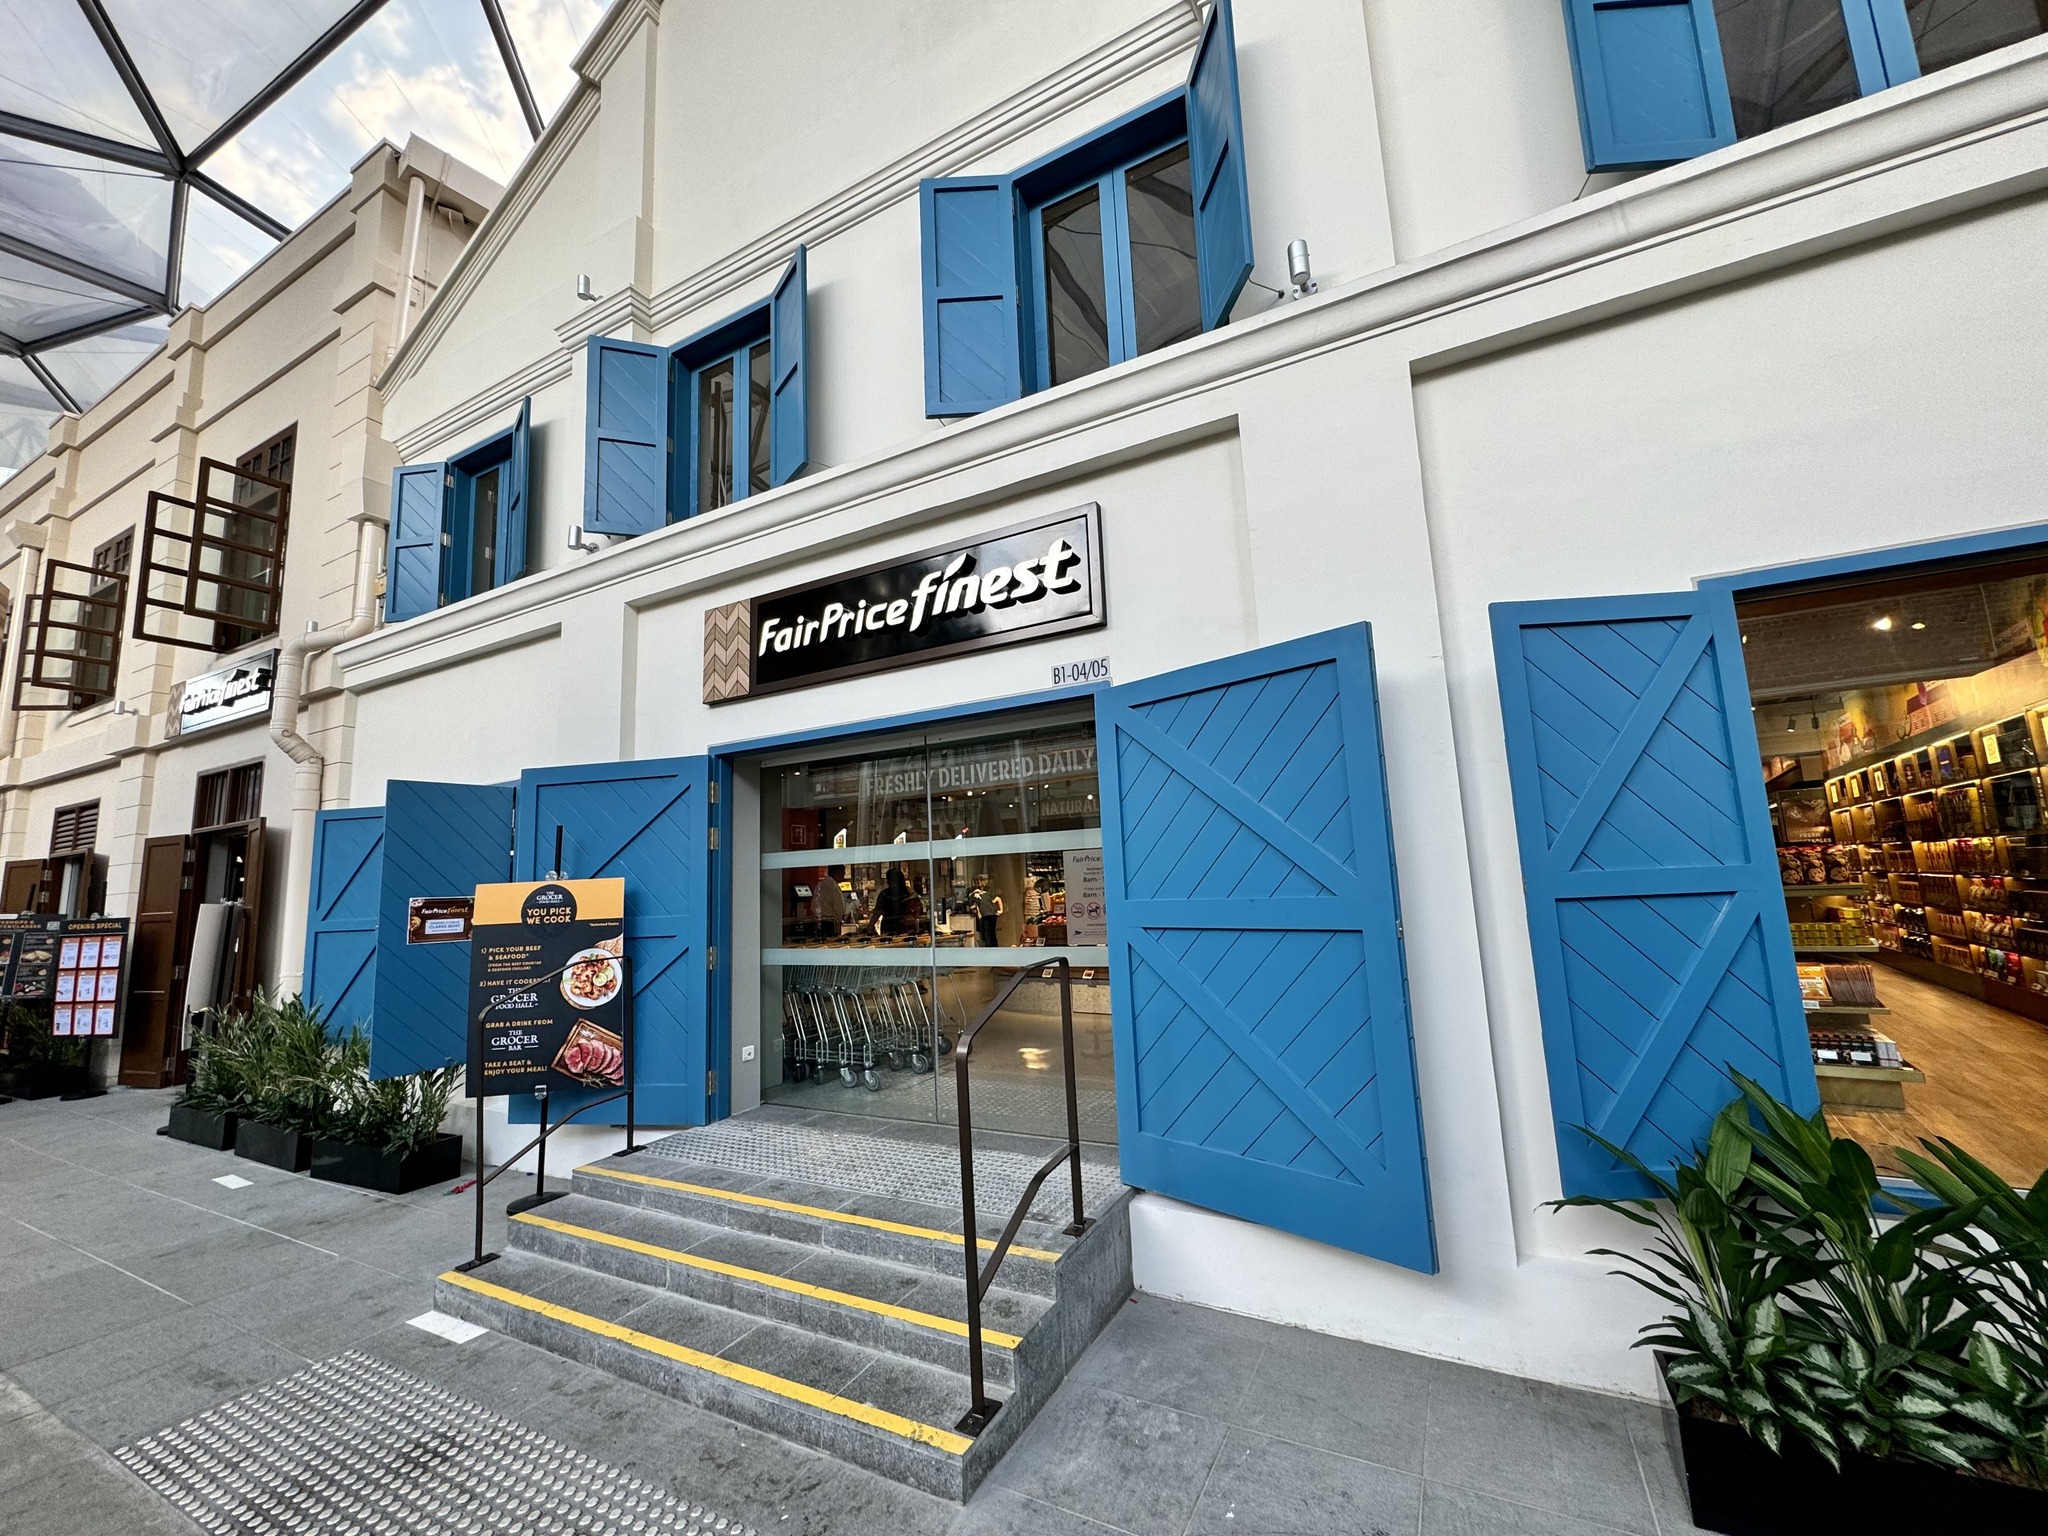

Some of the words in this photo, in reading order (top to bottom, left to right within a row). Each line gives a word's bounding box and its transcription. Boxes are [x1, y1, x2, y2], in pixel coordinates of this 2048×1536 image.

[757, 601, 906, 658] FairPrice
[908, 537, 1078, 632] finest
[1053, 658, 1108, 685] B1-04/05
[866, 769, 934, 797] FRESHLY
[938, 756, 1034, 788] DELIVERED
[1039, 748, 1096, 775] DAILY
[1072, 855, 1101, 863] FairPrice
[527, 908, 546, 916] YOU
[549, 907, 572, 915] PICK
[527, 916, 541, 925] WE
[543, 915, 571, 924] COOK
[68, 922, 96, 931] OPENING
[96, 921, 122, 930] SPECIAL
[491, 1034, 539, 1046] GROCER
[484, 1068, 506, 1077] ENJOY
